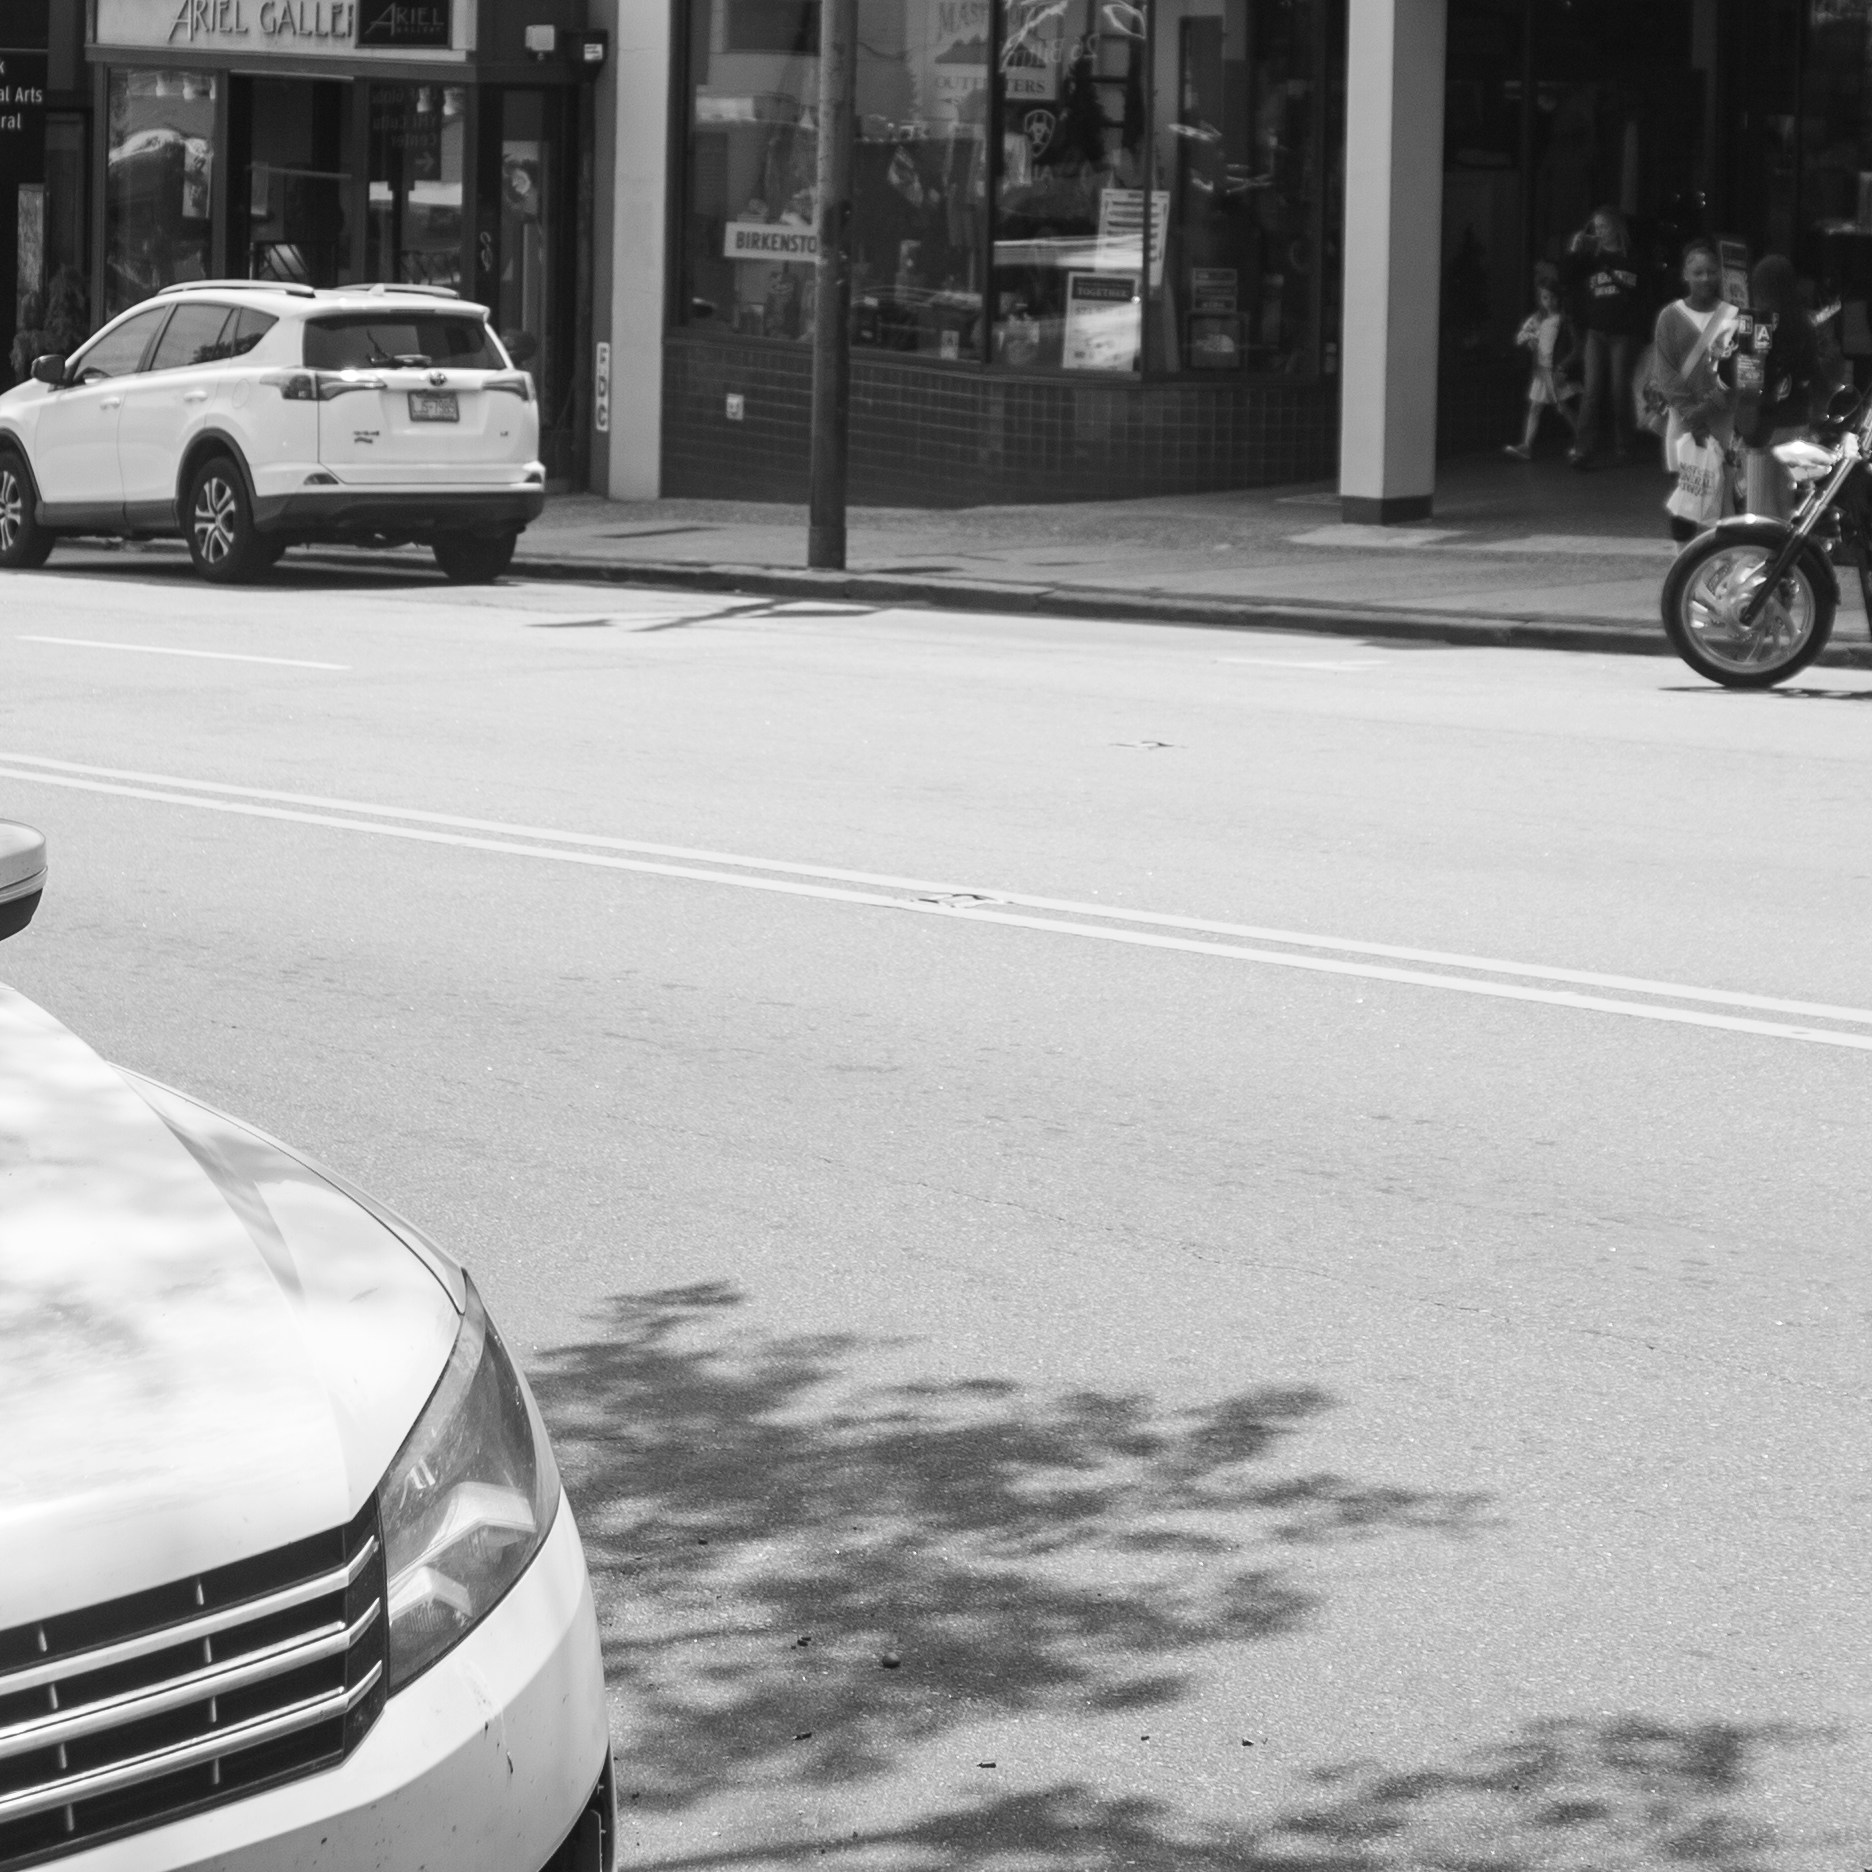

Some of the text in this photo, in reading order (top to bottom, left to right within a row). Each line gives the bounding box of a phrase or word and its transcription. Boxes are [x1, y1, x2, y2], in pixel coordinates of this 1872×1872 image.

[364, 2, 445, 36] ARIEL
[15, 87, 43, 103] Arts
[598, 345, 608, 427] FDC
